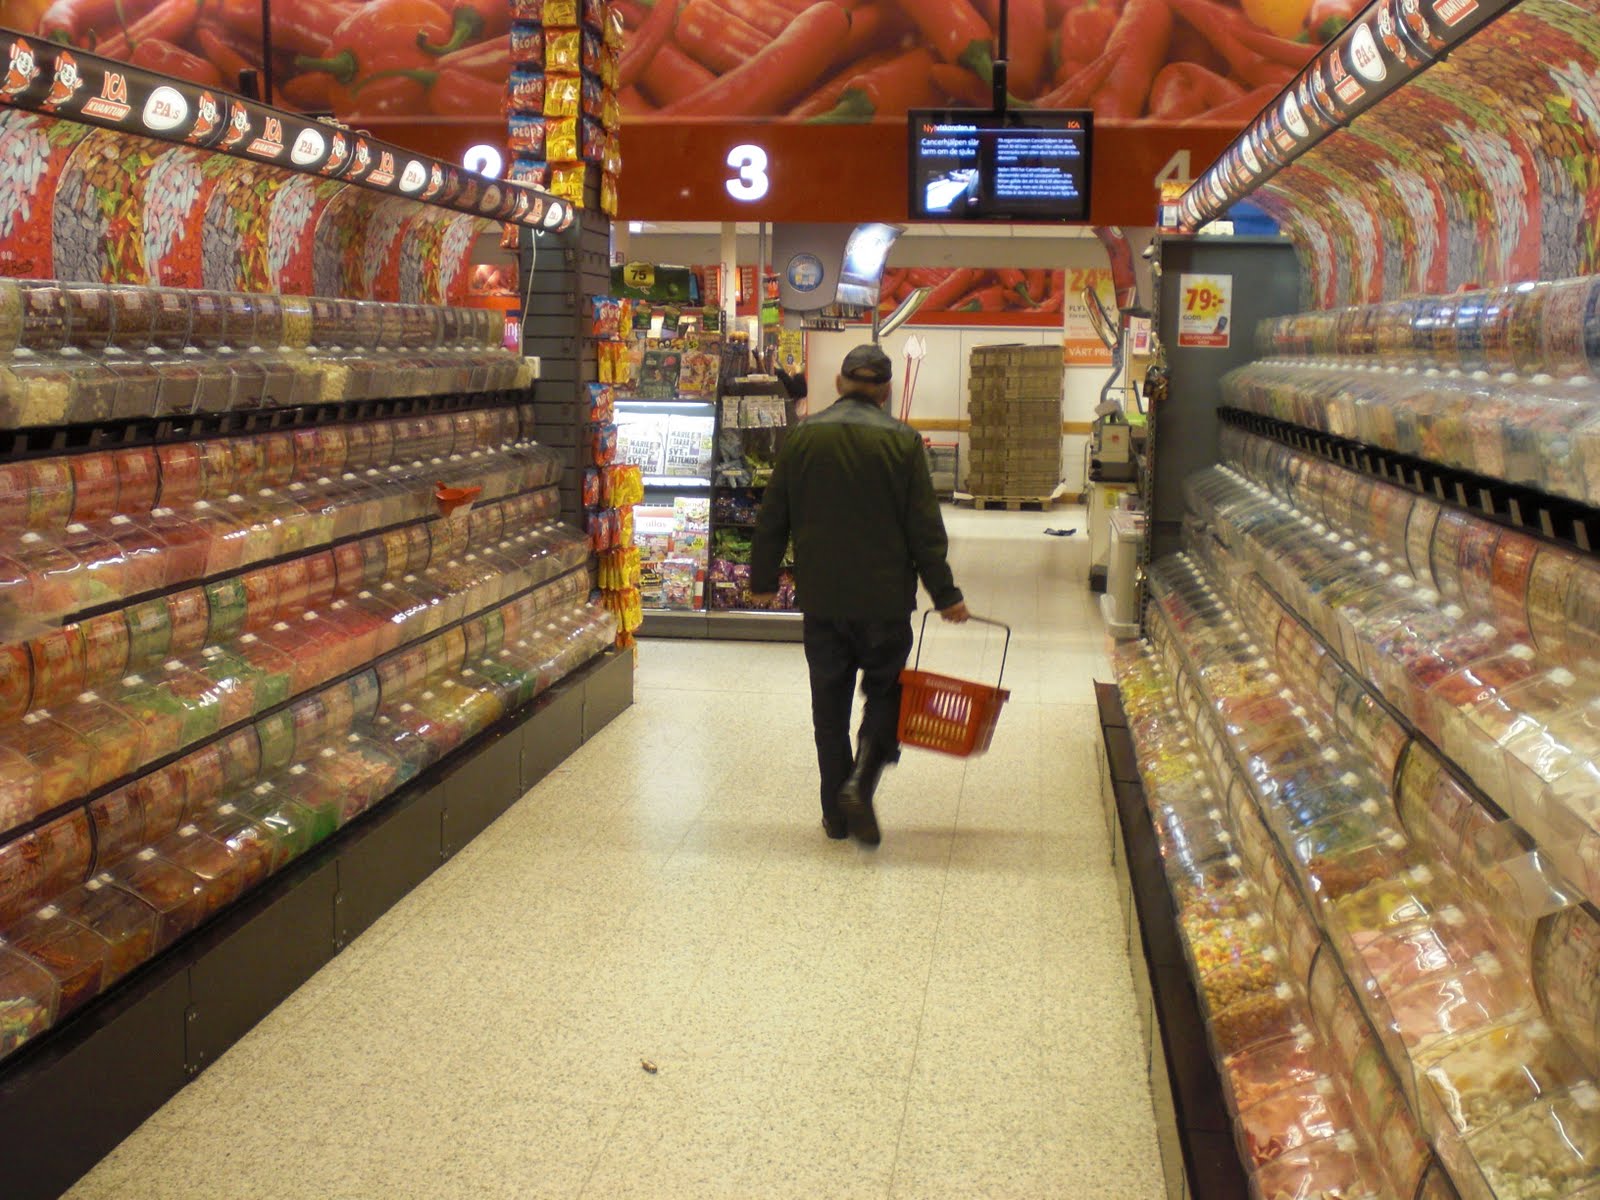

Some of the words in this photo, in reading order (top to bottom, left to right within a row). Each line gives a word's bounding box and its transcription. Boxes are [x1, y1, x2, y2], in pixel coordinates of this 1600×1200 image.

[101, 71, 127, 103] ICA
[85, 101, 128, 118] KVANTUM
[262, 116, 282, 143] ICA
[512, 126, 543, 139] PLOPP
[1067, 120, 1080, 129] ICA
[921, 147, 936, 155] larm
[949, 147, 958, 155] de
[959, 147, 975, 156] sjuka
[726, 144, 769, 201] 3
[1155, 149, 1192, 189] 4
[630, 270, 647, 281] 75
[1185, 288, 1226, 311] 79:-
[1069, 346, 1093, 357] VÅRT
